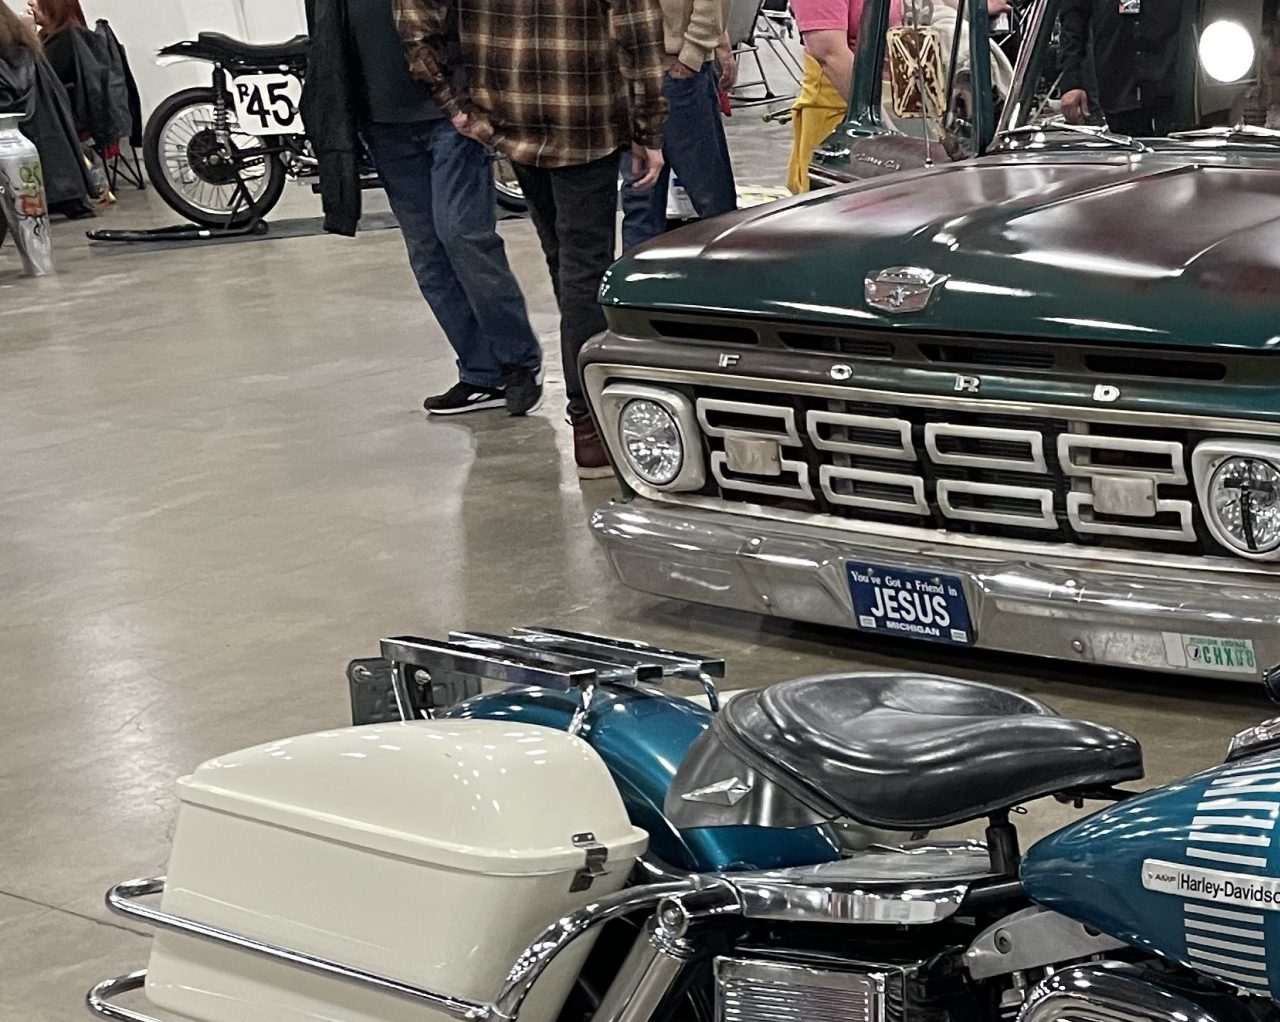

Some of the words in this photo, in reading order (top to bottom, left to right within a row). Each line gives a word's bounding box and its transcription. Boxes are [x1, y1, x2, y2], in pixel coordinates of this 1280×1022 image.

[246, 81, 298, 128] 45
[718, 353, 1120, 402] FORD
[851, 570, 881, 585] You've
[885, 575, 901, 588] Got
[905, 580, 912, 589] a
[915, 580, 944, 595] Friend
[948, 585, 958, 597] in
[870, 586, 950, 627] JESUS
[886, 621, 940, 637] MICHIGAN
